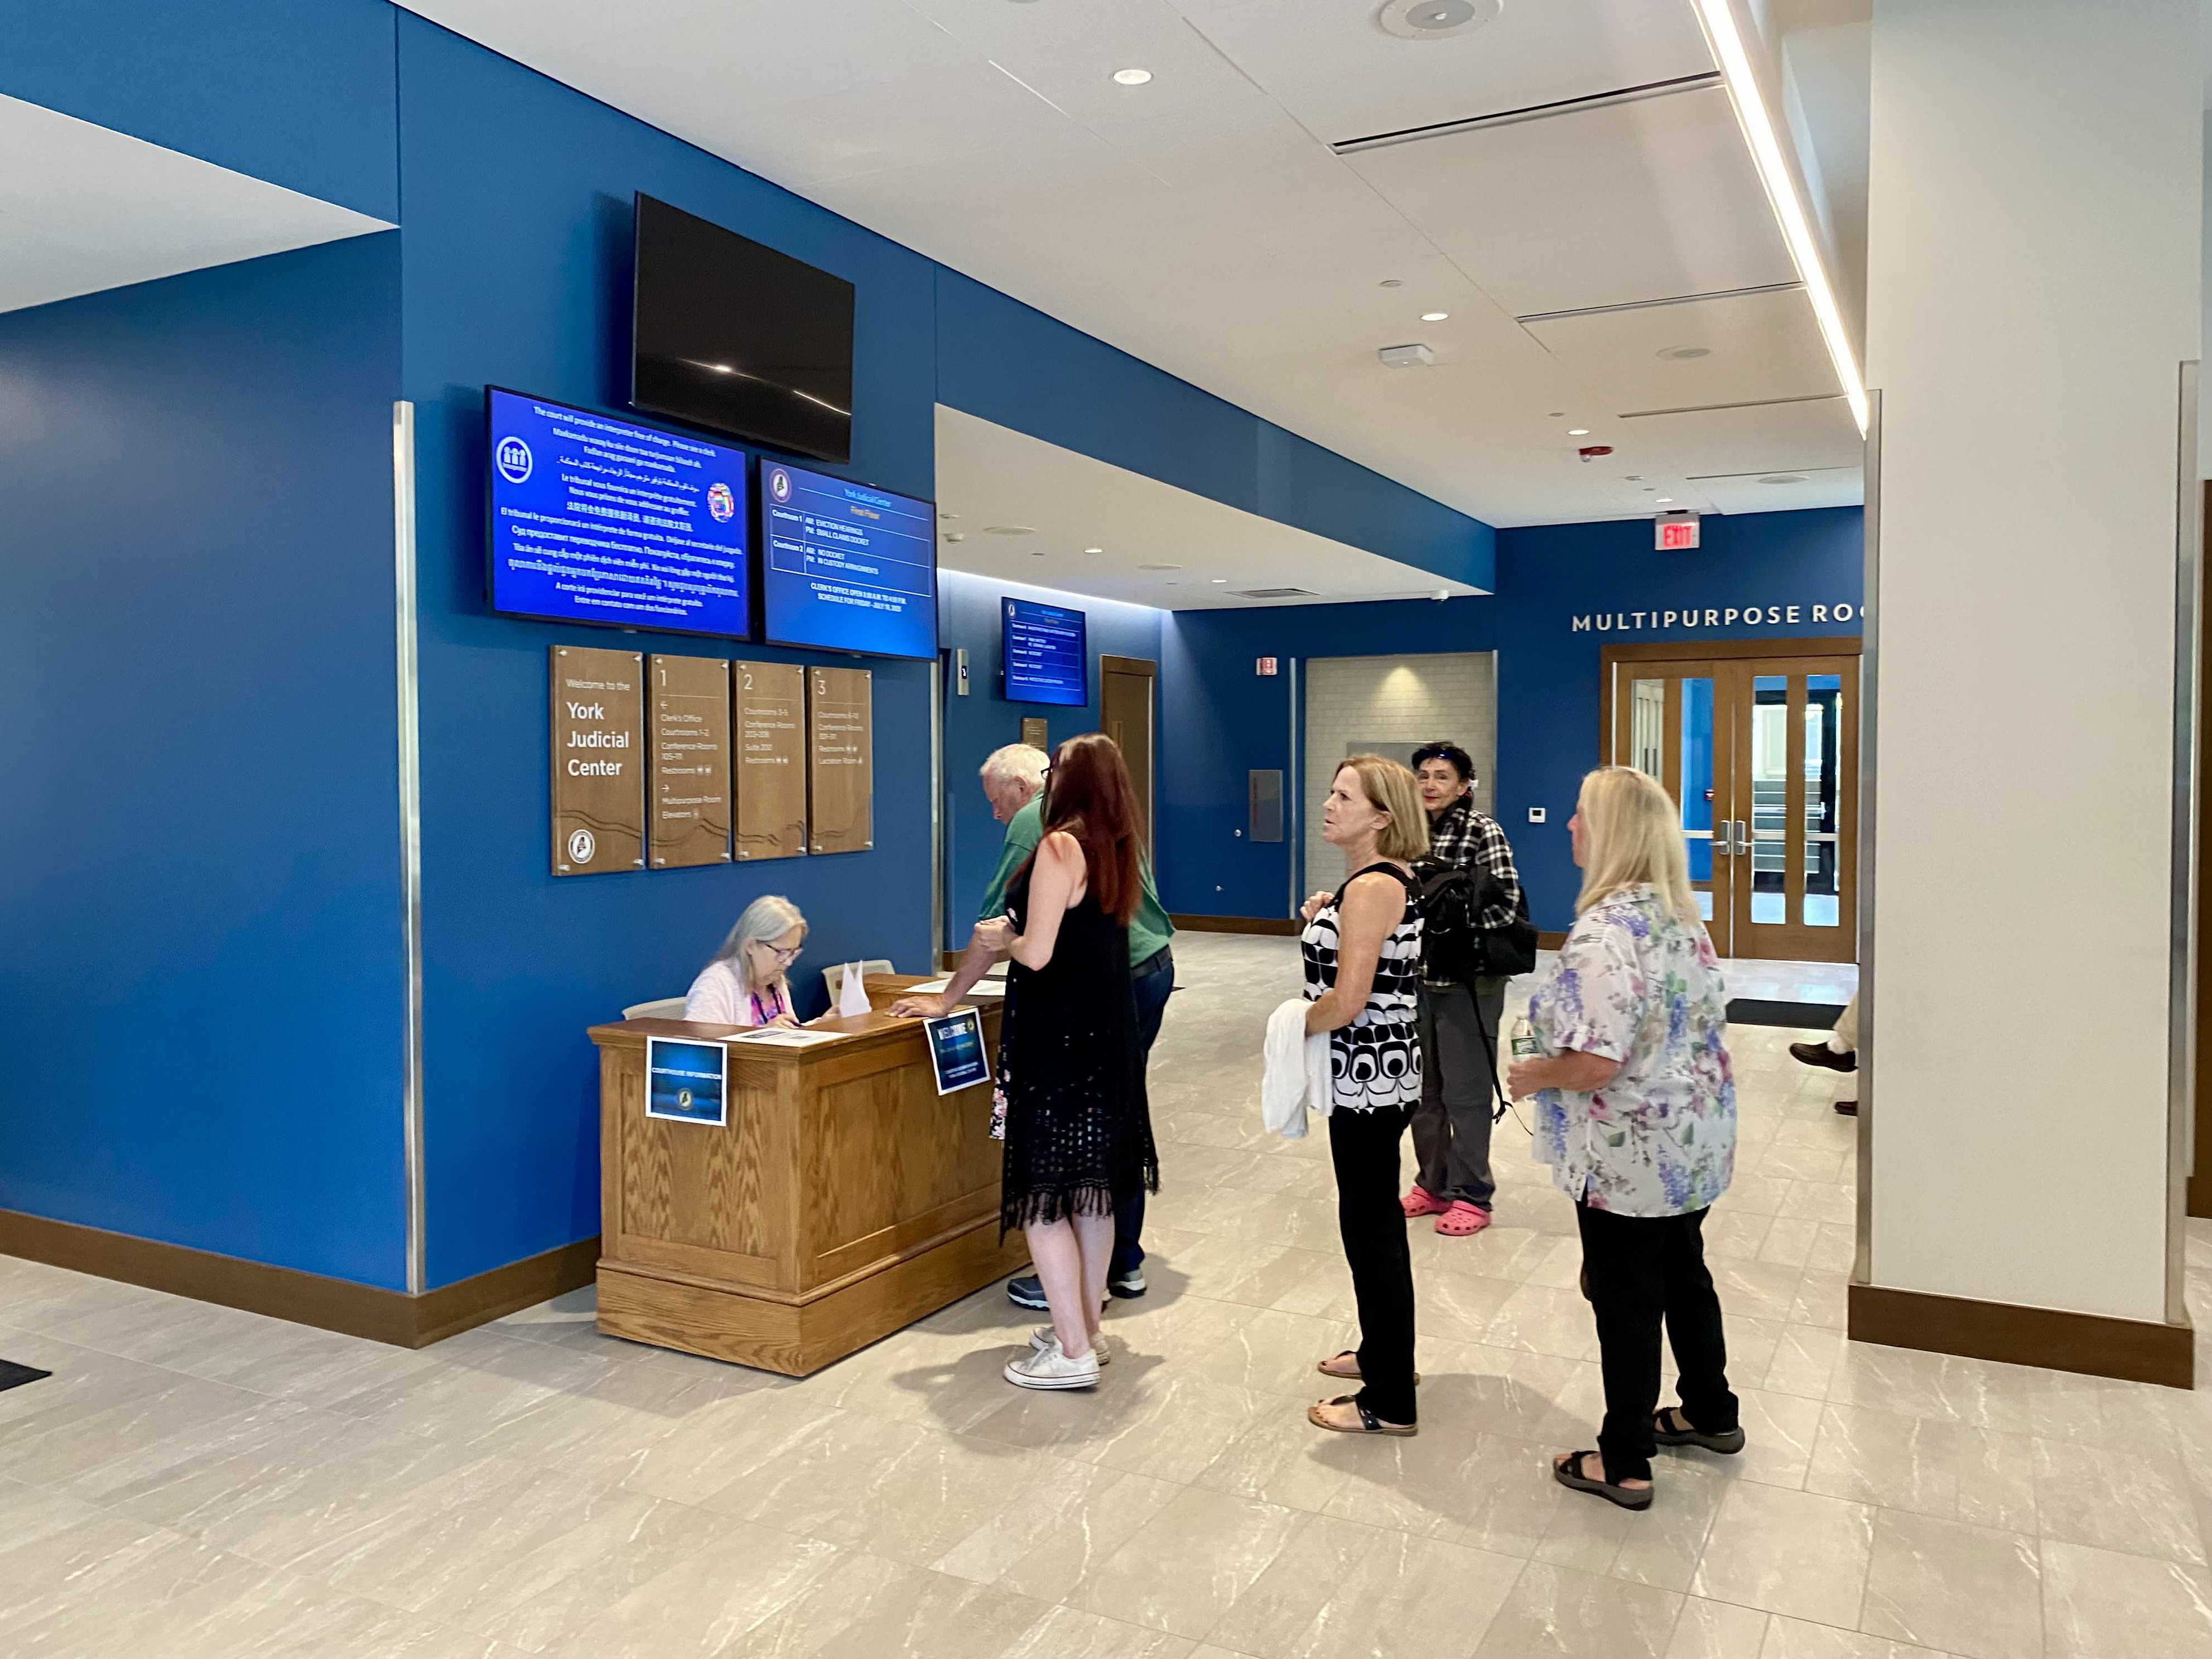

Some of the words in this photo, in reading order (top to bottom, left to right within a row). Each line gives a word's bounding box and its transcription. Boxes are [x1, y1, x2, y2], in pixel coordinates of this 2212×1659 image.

[1664, 525, 1693, 547] EXIT
[1572, 605, 1800, 631] MULTIPURPOSE
[1812, 603, 1864, 623] RO
[566, 678, 605, 689] Welcome
[606, 681, 615, 690] to
[616, 682, 630, 691] the
[660, 669, 666, 686] 1
[744, 674, 753, 689] 2
[817, 680, 826, 695] 3
[566, 702, 604, 720] York
[683, 715, 702, 723] Office
[567, 731, 629, 748] Judicial
[568, 759, 623, 776] Center
